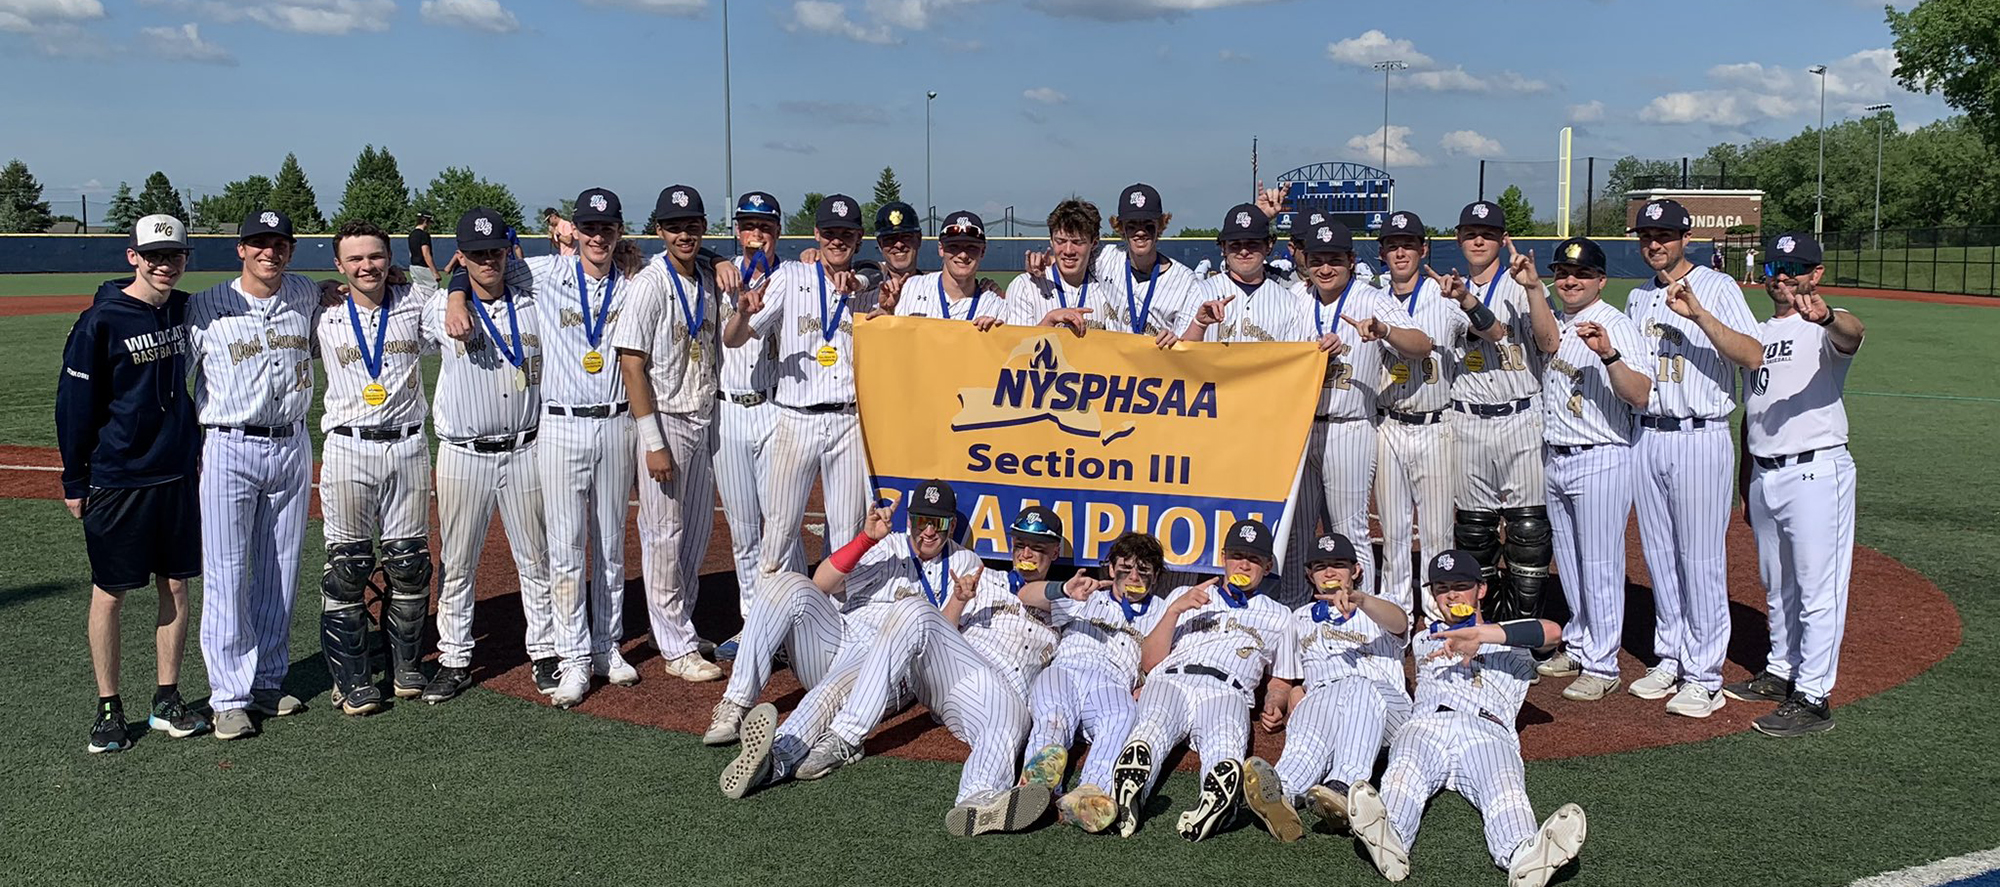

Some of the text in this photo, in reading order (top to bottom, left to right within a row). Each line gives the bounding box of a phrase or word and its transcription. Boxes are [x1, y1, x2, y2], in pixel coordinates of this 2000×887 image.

[154, 222, 173, 237] WG
[1690, 215, 1743, 228] ONDAGA
[228, 334, 263, 366] West
[1323, 362, 1353, 390] 22
[1422, 357, 1438, 384] 9
[1657, 352, 1685, 384] 19
[992, 368, 1218, 418] NYSPHSAA
[967, 443, 1190, 484] Section III
[875, 487, 1279, 567] AMPION
[1511, 567, 1547, 577] EASTON
